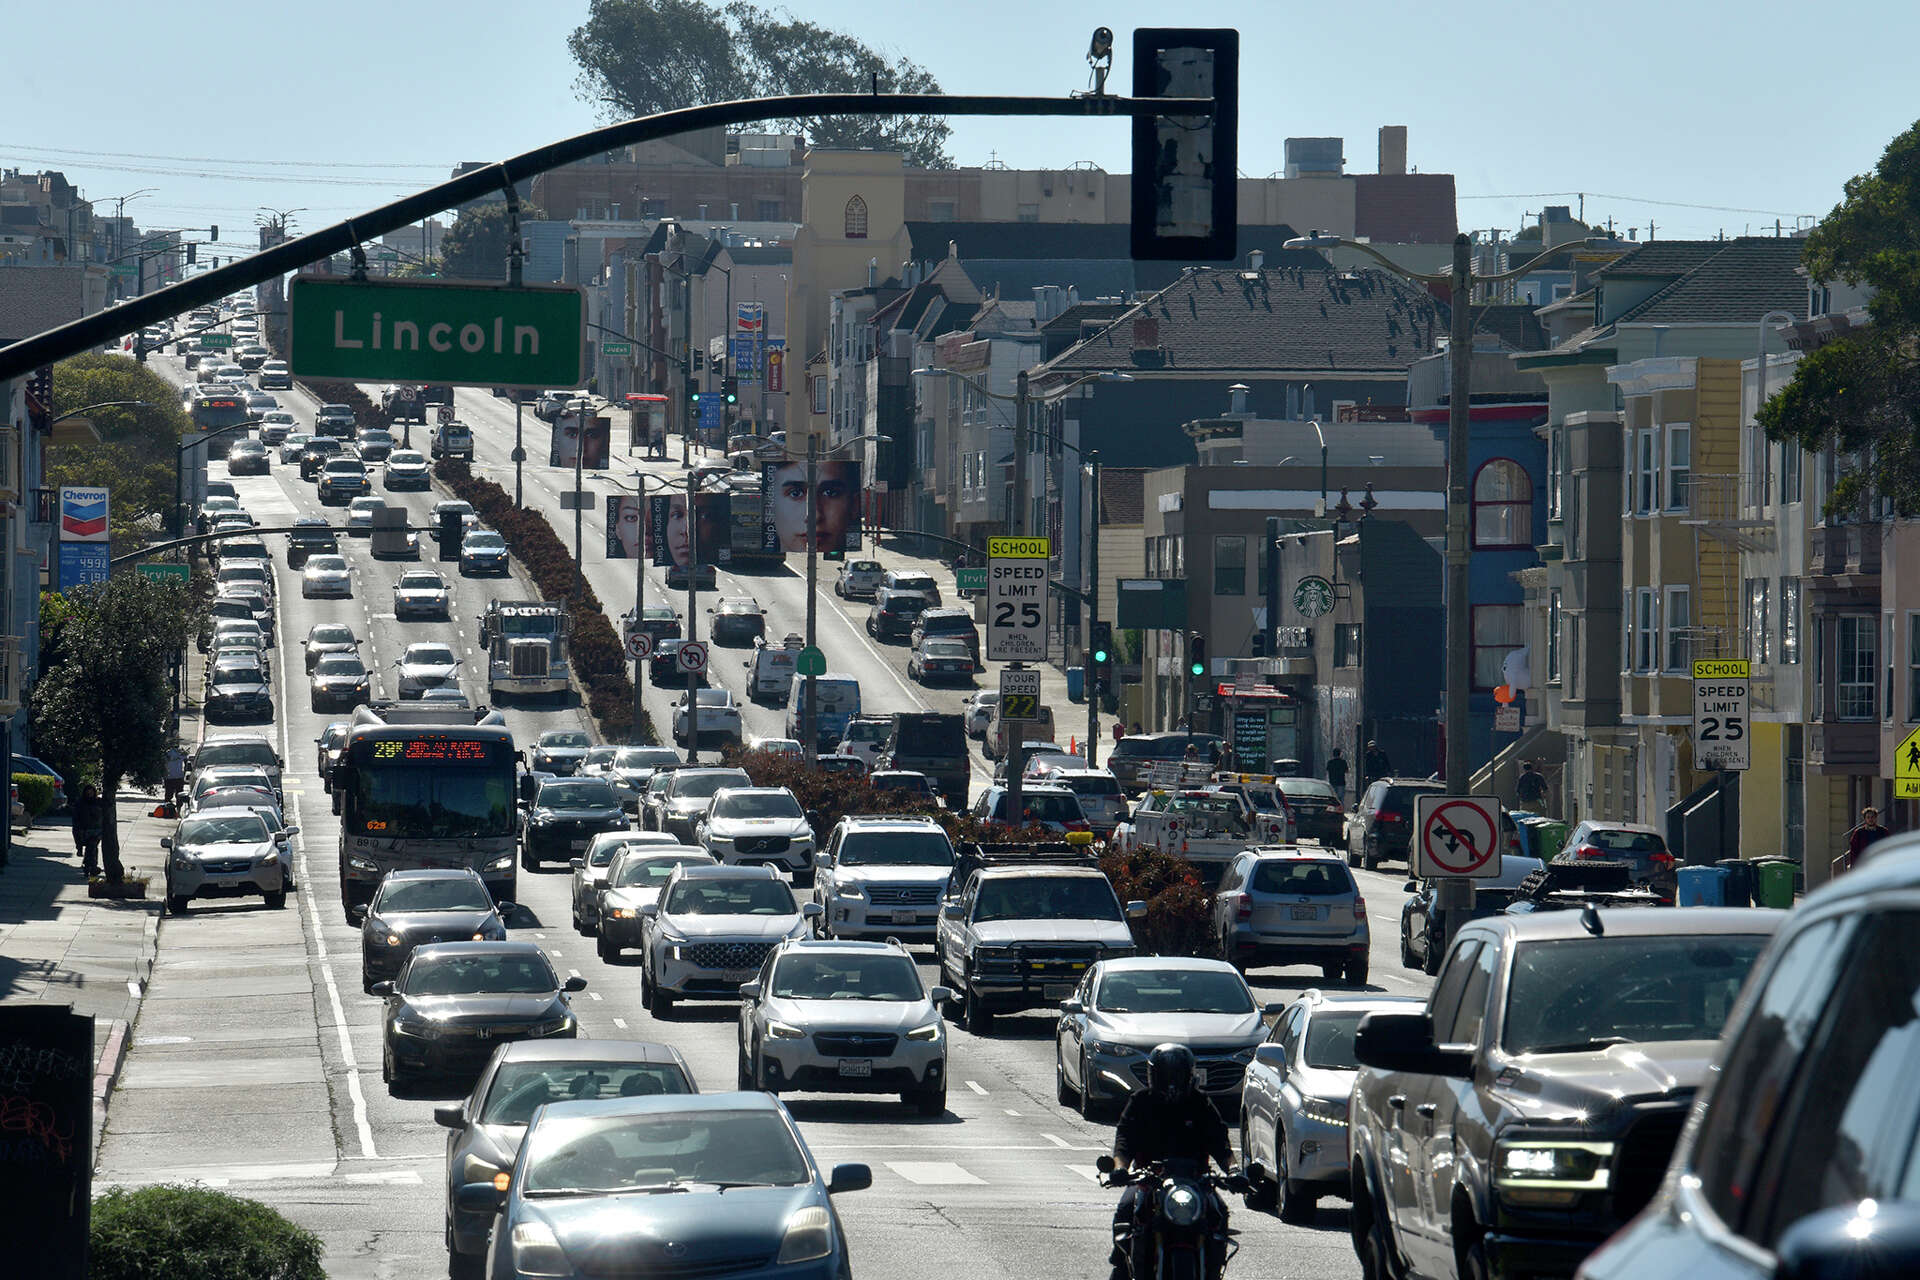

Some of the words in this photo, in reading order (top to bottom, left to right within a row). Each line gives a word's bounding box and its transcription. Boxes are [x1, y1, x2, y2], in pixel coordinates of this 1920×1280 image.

[334, 310, 539, 355] Lincoln
[63, 490, 106, 500] Chevron
[992, 542, 1045, 554] SCHOOL
[993, 567, 1044, 579] SPEED
[999, 584, 1038, 597] LIMIT
[994, 602, 1041, 628] 25
[1008, 633, 1028, 641] WHEN
[992, 646, 1008, 654] ARE
[1010, 646, 1042, 654] PRESENT
[1696, 663, 1746, 675] SCHOOL
[1006, 674, 1035, 683] YOUR
[1003, 685, 1037, 694] SPEED
[1698, 686, 1745, 697] SPEED
[1004, 695, 1035, 718] 22
[1703, 702, 1740, 713] LIMIT
[1700, 717, 1744, 741] 25
[450, 742, 481, 751] RAPID
[1713, 744, 1731, 752] WHEN
[1905, 783, 1920, 793] AH
